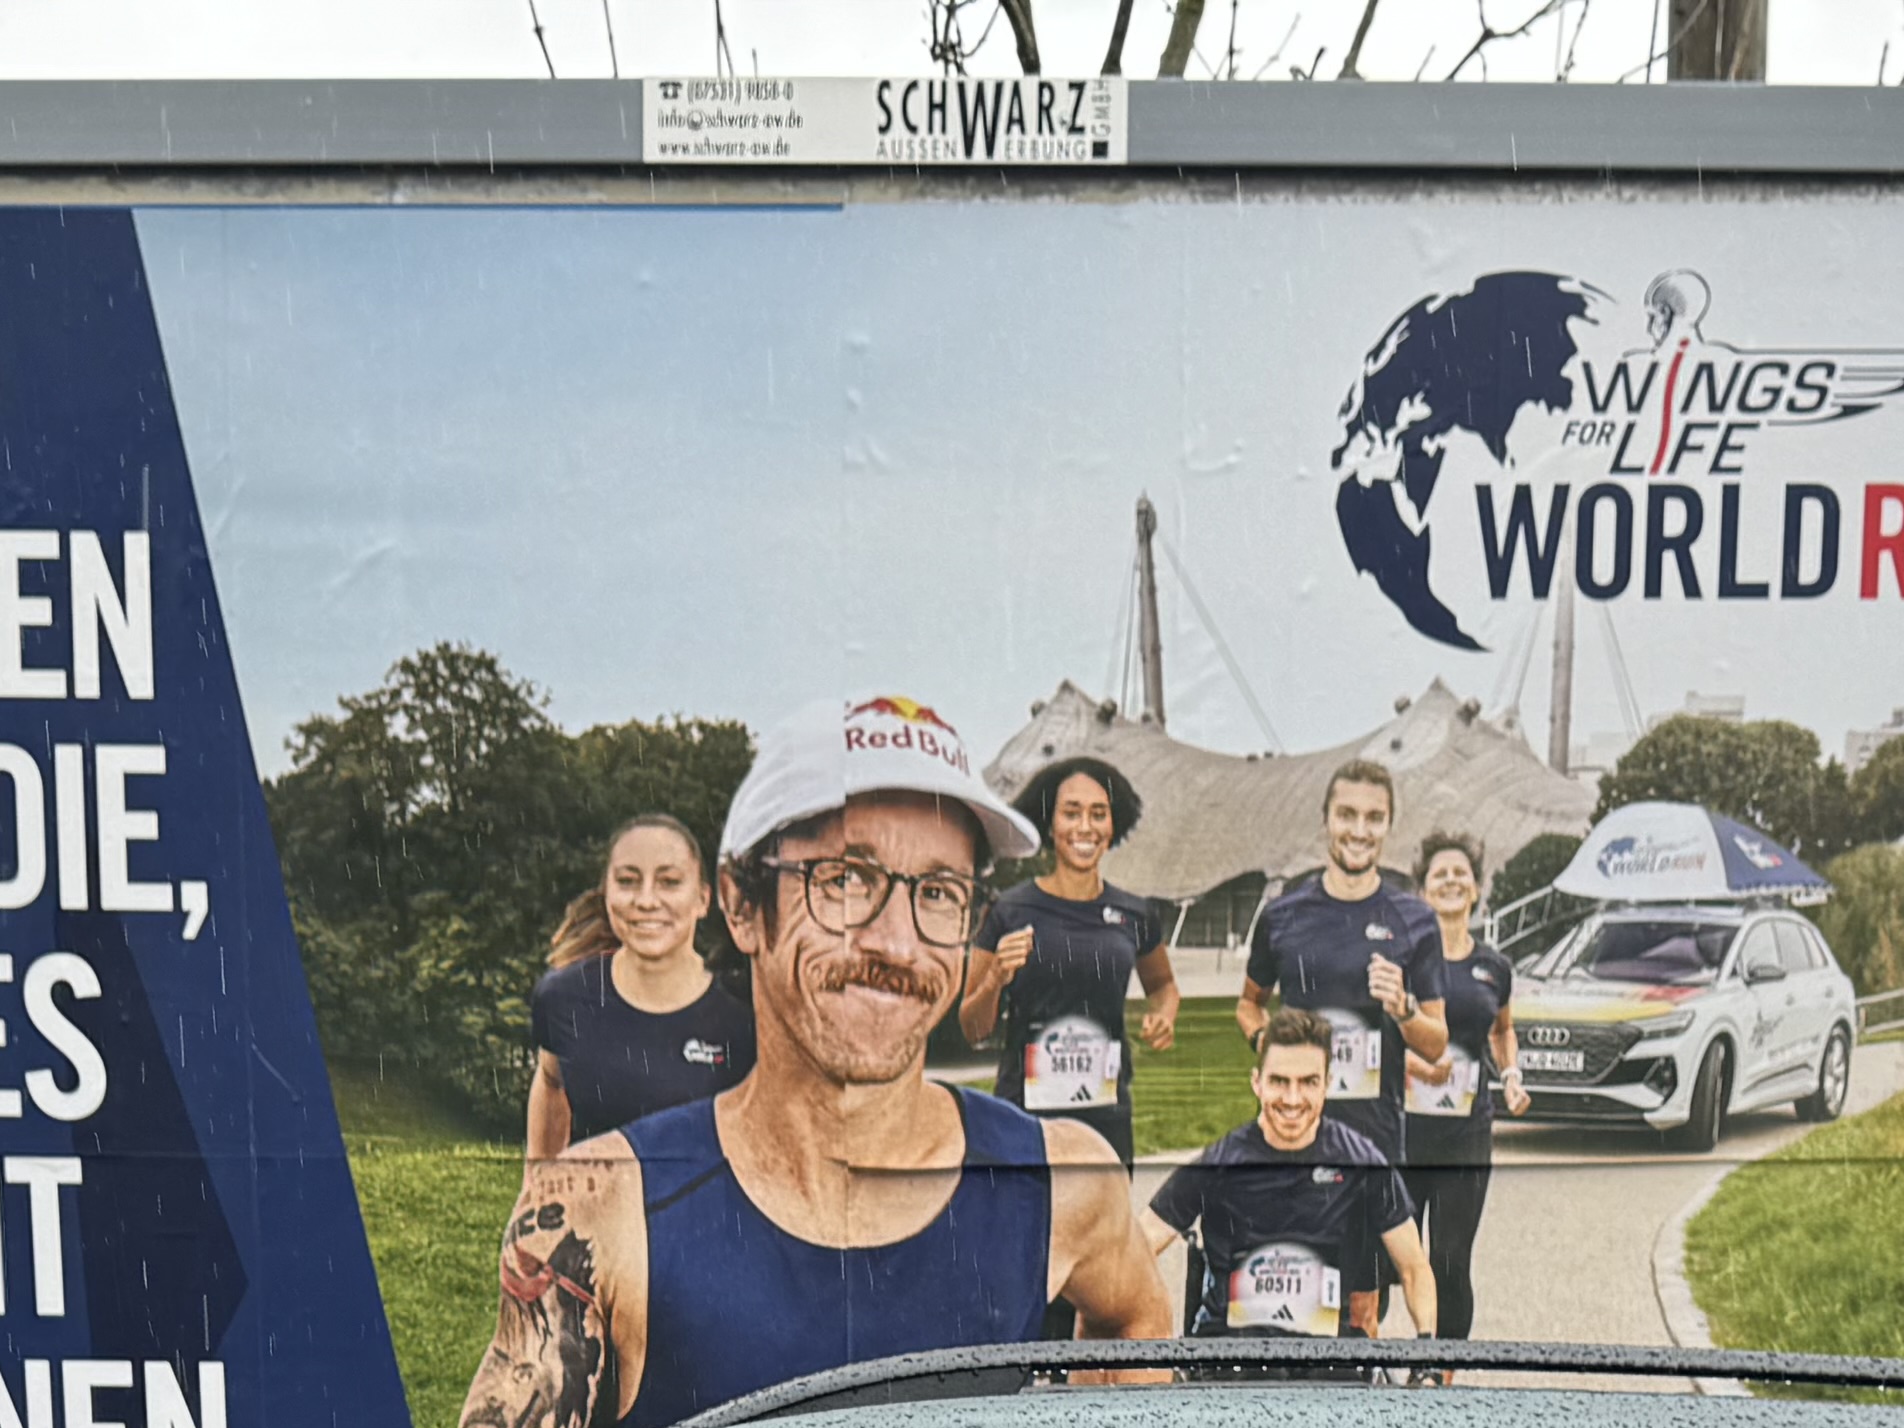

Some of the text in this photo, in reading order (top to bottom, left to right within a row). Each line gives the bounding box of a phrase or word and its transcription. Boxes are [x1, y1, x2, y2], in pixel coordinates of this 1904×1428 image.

[877, 79, 1087, 160] SCHWARZ
[1582, 354, 1836, 414] WINGS
[1562, 421, 1761, 476] FOR LIFE
[1475, 481, 1842, 601] WORLD
